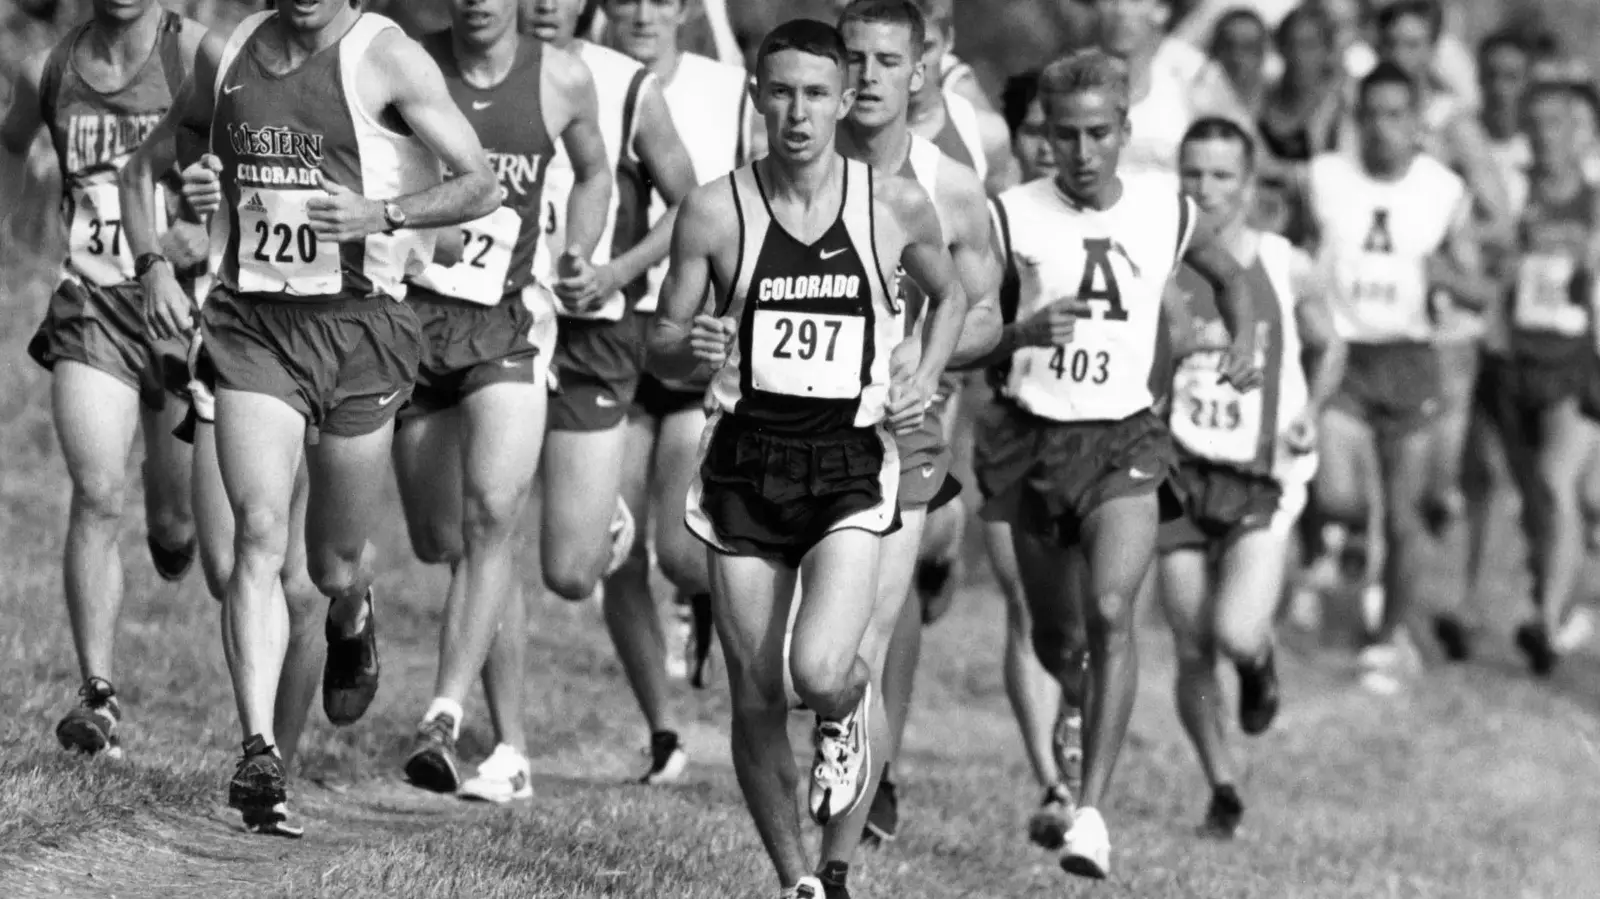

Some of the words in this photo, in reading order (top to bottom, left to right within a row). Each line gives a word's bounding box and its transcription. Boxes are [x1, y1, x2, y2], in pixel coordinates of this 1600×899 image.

[227, 122, 324, 169] WESTERN
[254, 219, 317, 263] 220
[1363, 207, 1393, 253] A
[759, 273, 860, 301] COLORADO
[1077, 237, 1128, 321] A
[772, 317, 843, 362] 297
[1048, 345, 1110, 385] 403
